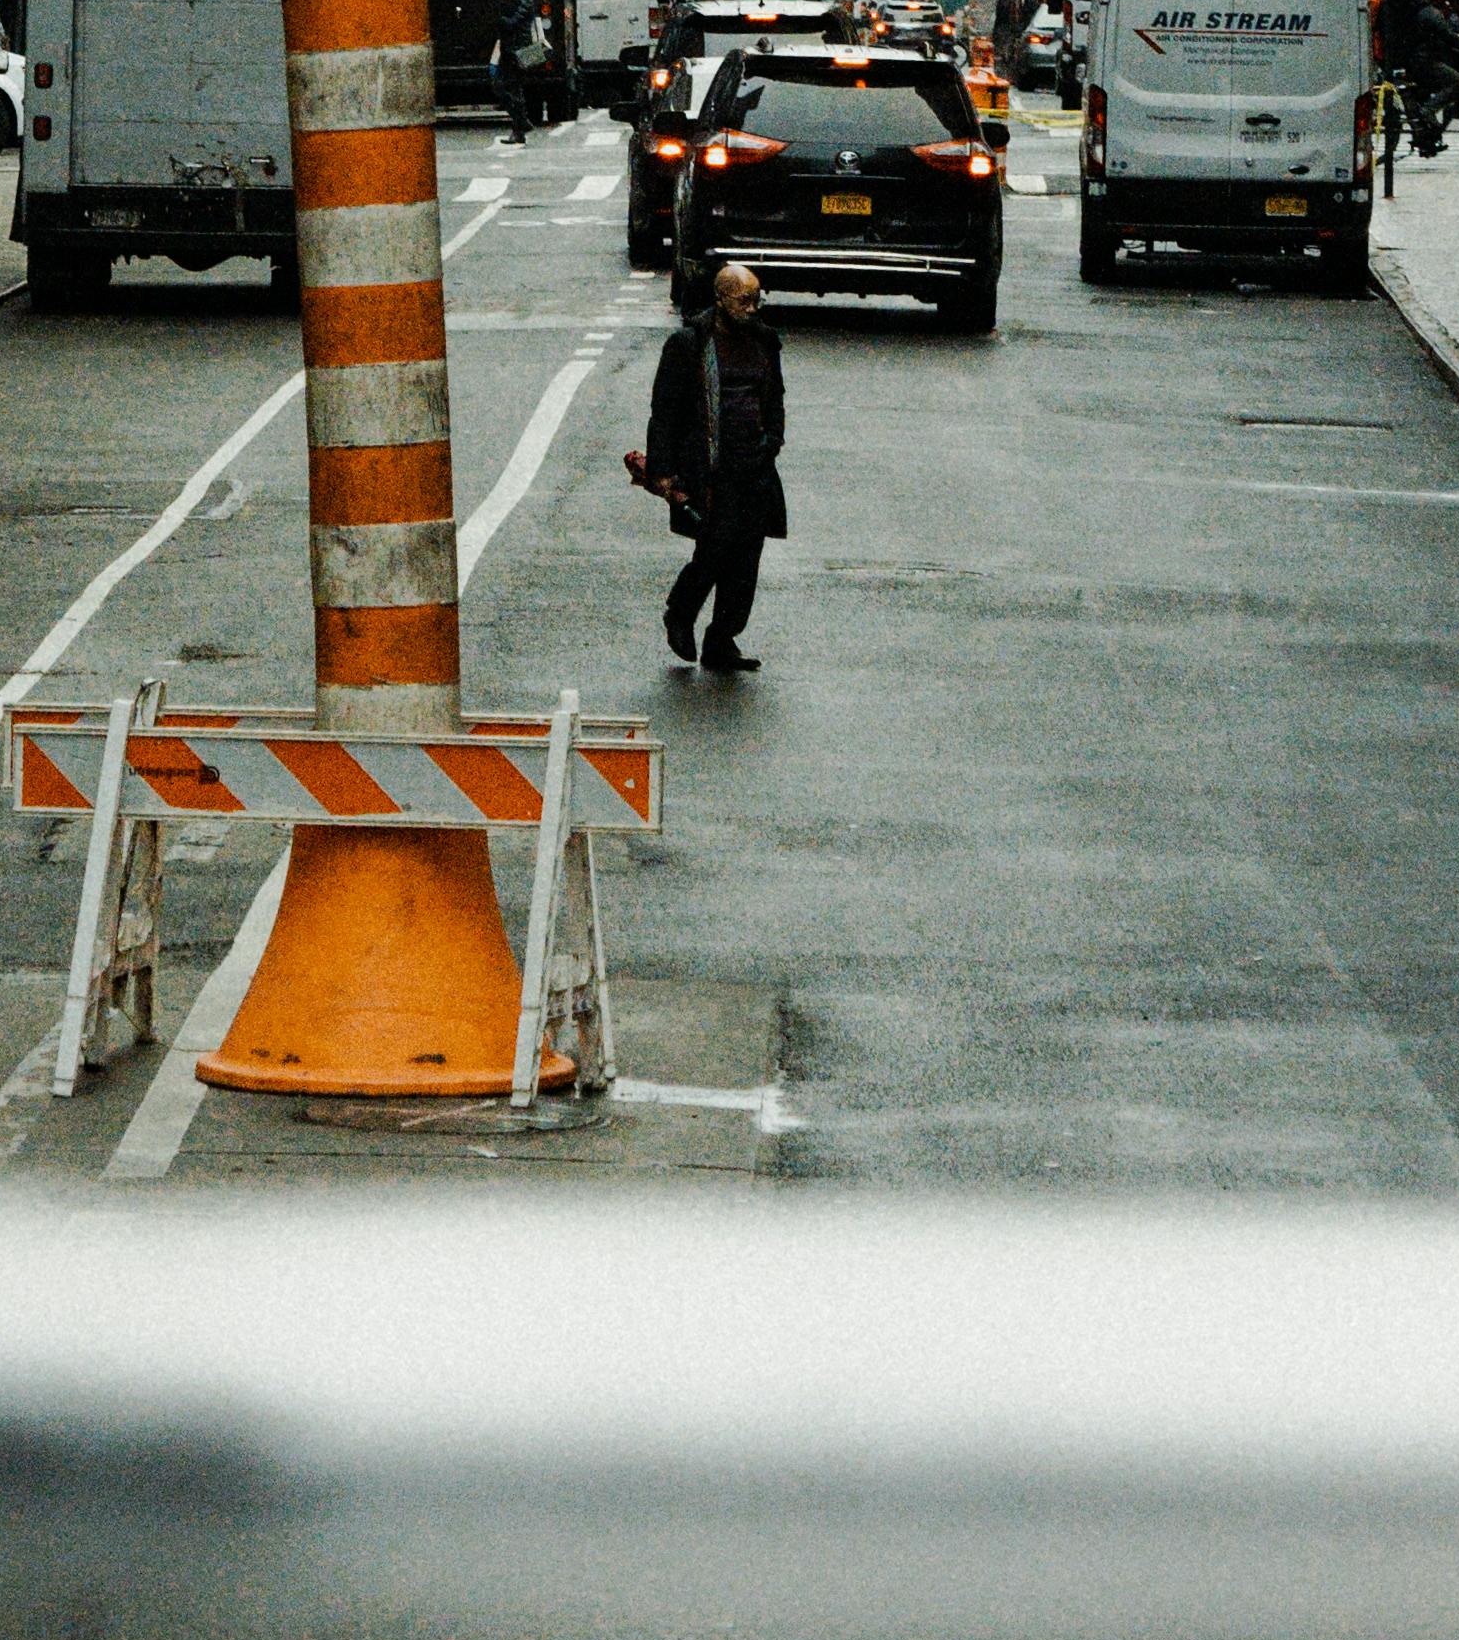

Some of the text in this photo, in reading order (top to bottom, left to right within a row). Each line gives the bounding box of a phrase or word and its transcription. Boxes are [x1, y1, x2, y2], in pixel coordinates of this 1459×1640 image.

[1151, 11, 1313, 32] AIR STREAM
[1155, 34, 1304, 46] AIR CONDITIONING CORPORATION
